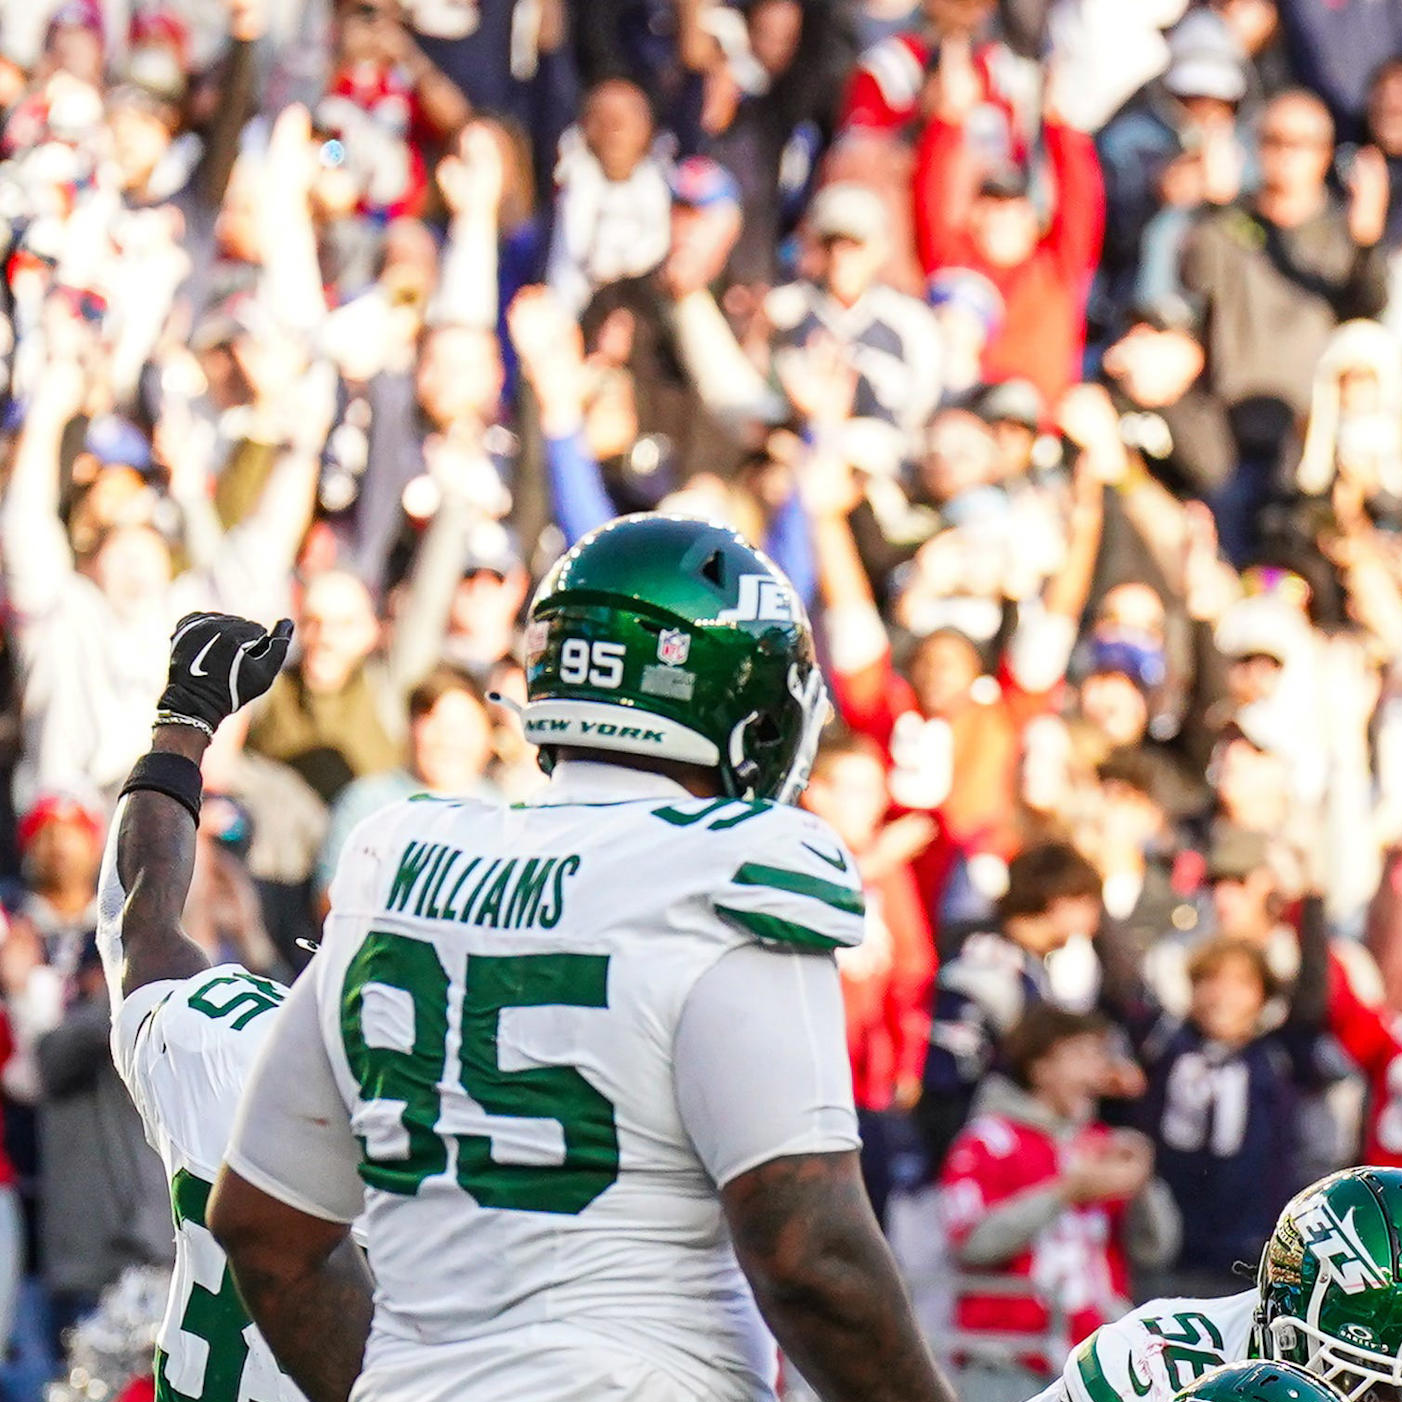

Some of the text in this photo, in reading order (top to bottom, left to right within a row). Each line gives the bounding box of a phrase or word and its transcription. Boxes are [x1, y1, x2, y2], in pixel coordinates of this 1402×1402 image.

[717, 574, 795, 622] JE
[559, 637, 627, 689] 95
[524, 718, 667, 743] NEW YORK
[386, 840, 581, 930] WILLIAMS
[342, 930, 620, 1215] 95
